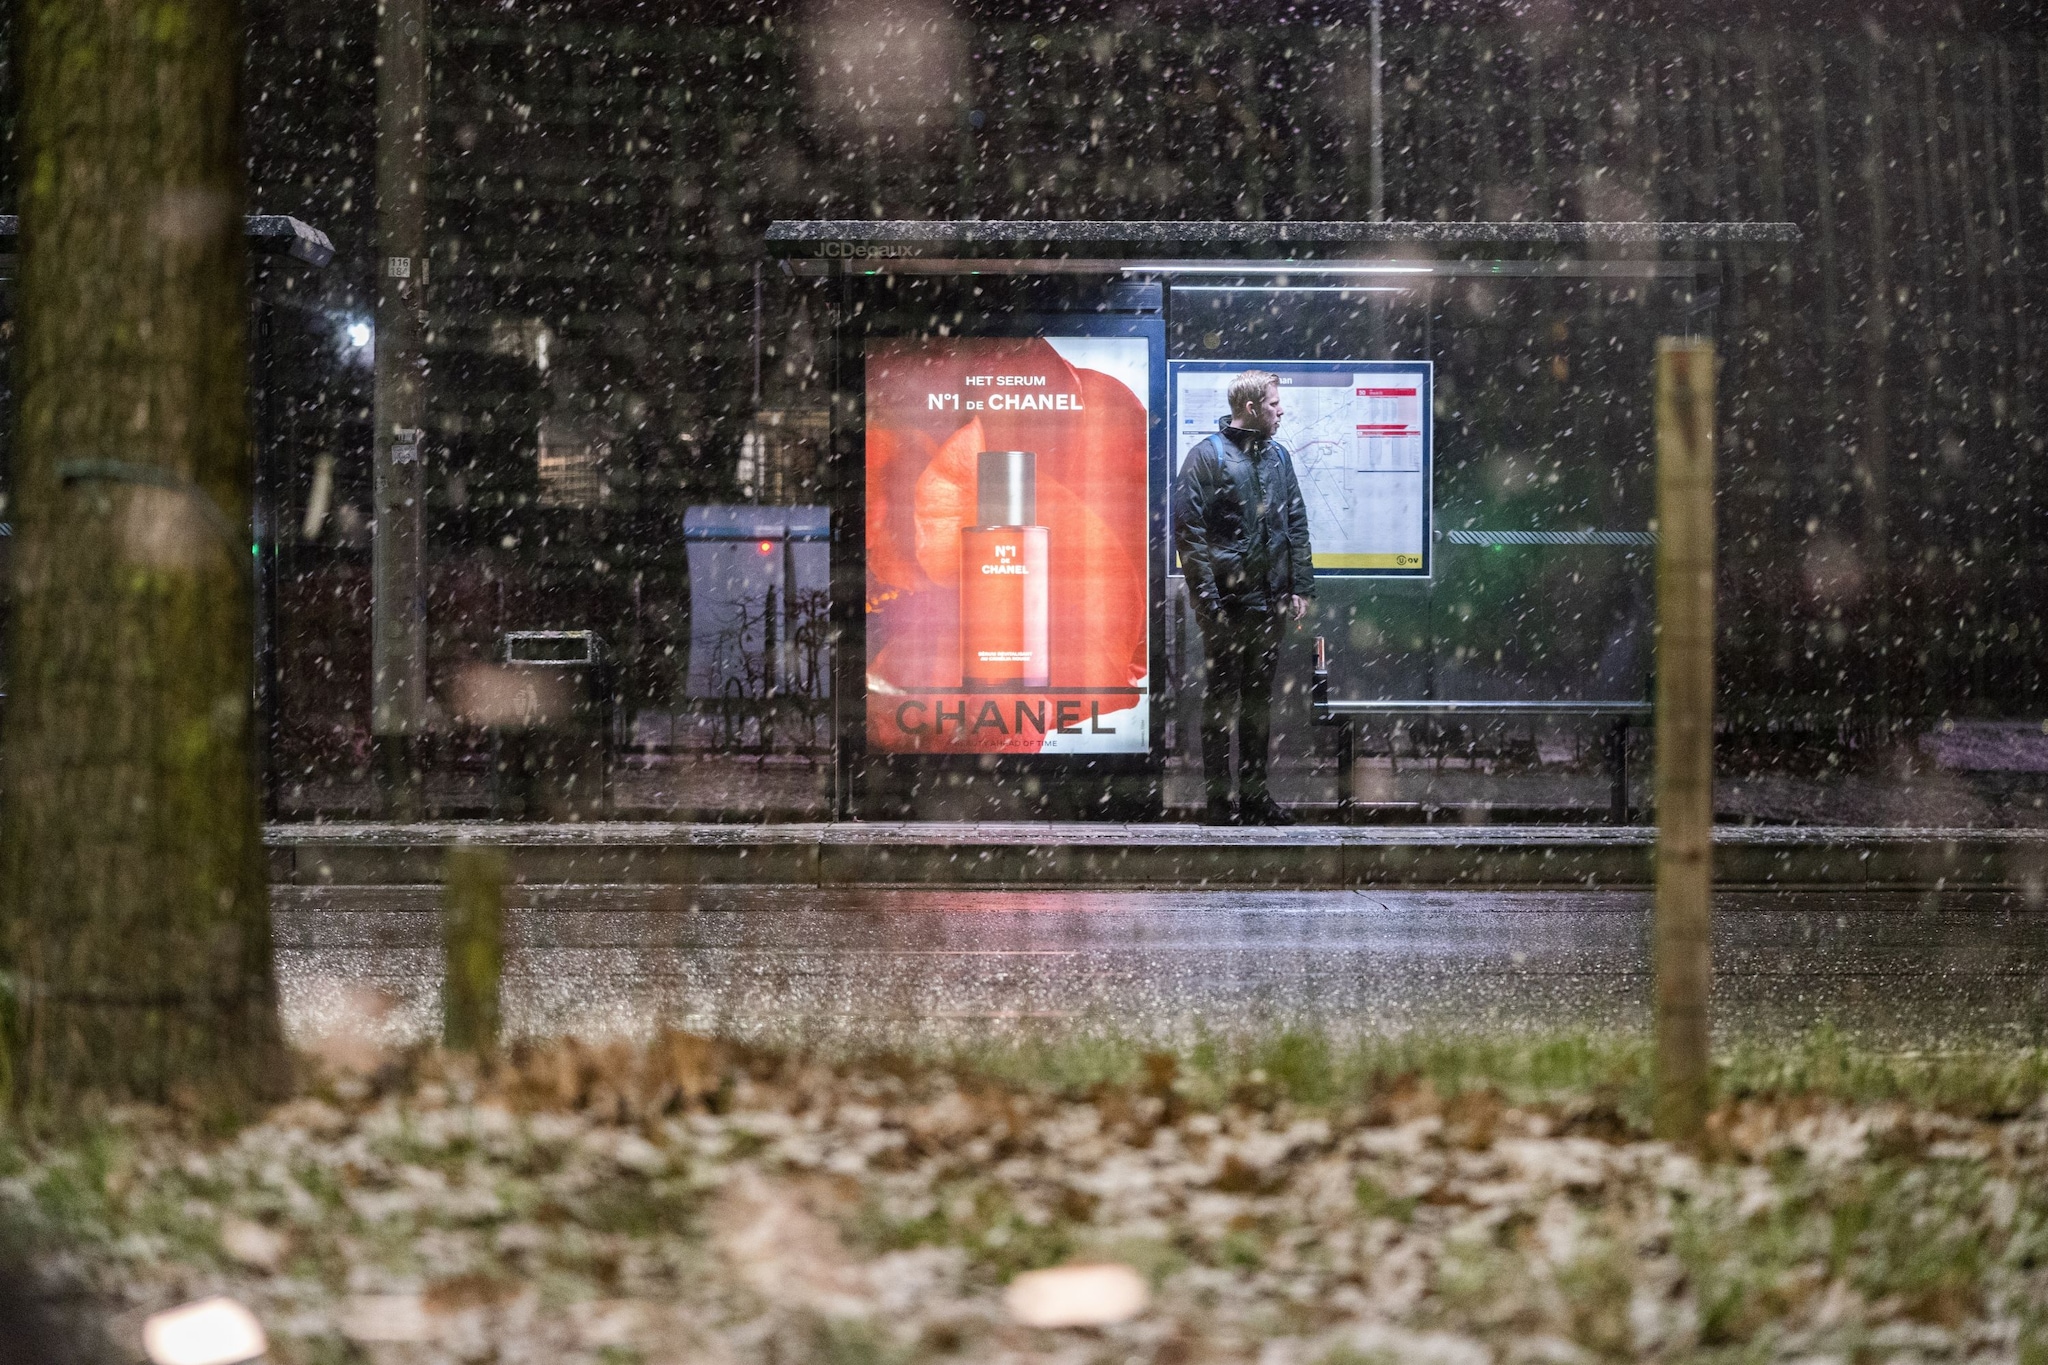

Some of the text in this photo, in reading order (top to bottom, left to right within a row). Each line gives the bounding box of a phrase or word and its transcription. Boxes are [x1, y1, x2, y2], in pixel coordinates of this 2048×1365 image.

[813, 241, 913, 257] JCDecaux
[391, 258, 409, 267] 116
[965, 376, 1046, 386] HET SERUM
[966, 401, 984, 410] DE
[988, 393, 1083, 410] CHANEL
[981, 564, 1030, 575] CHANEL
[895, 700, 1117, 735] CHANEL
